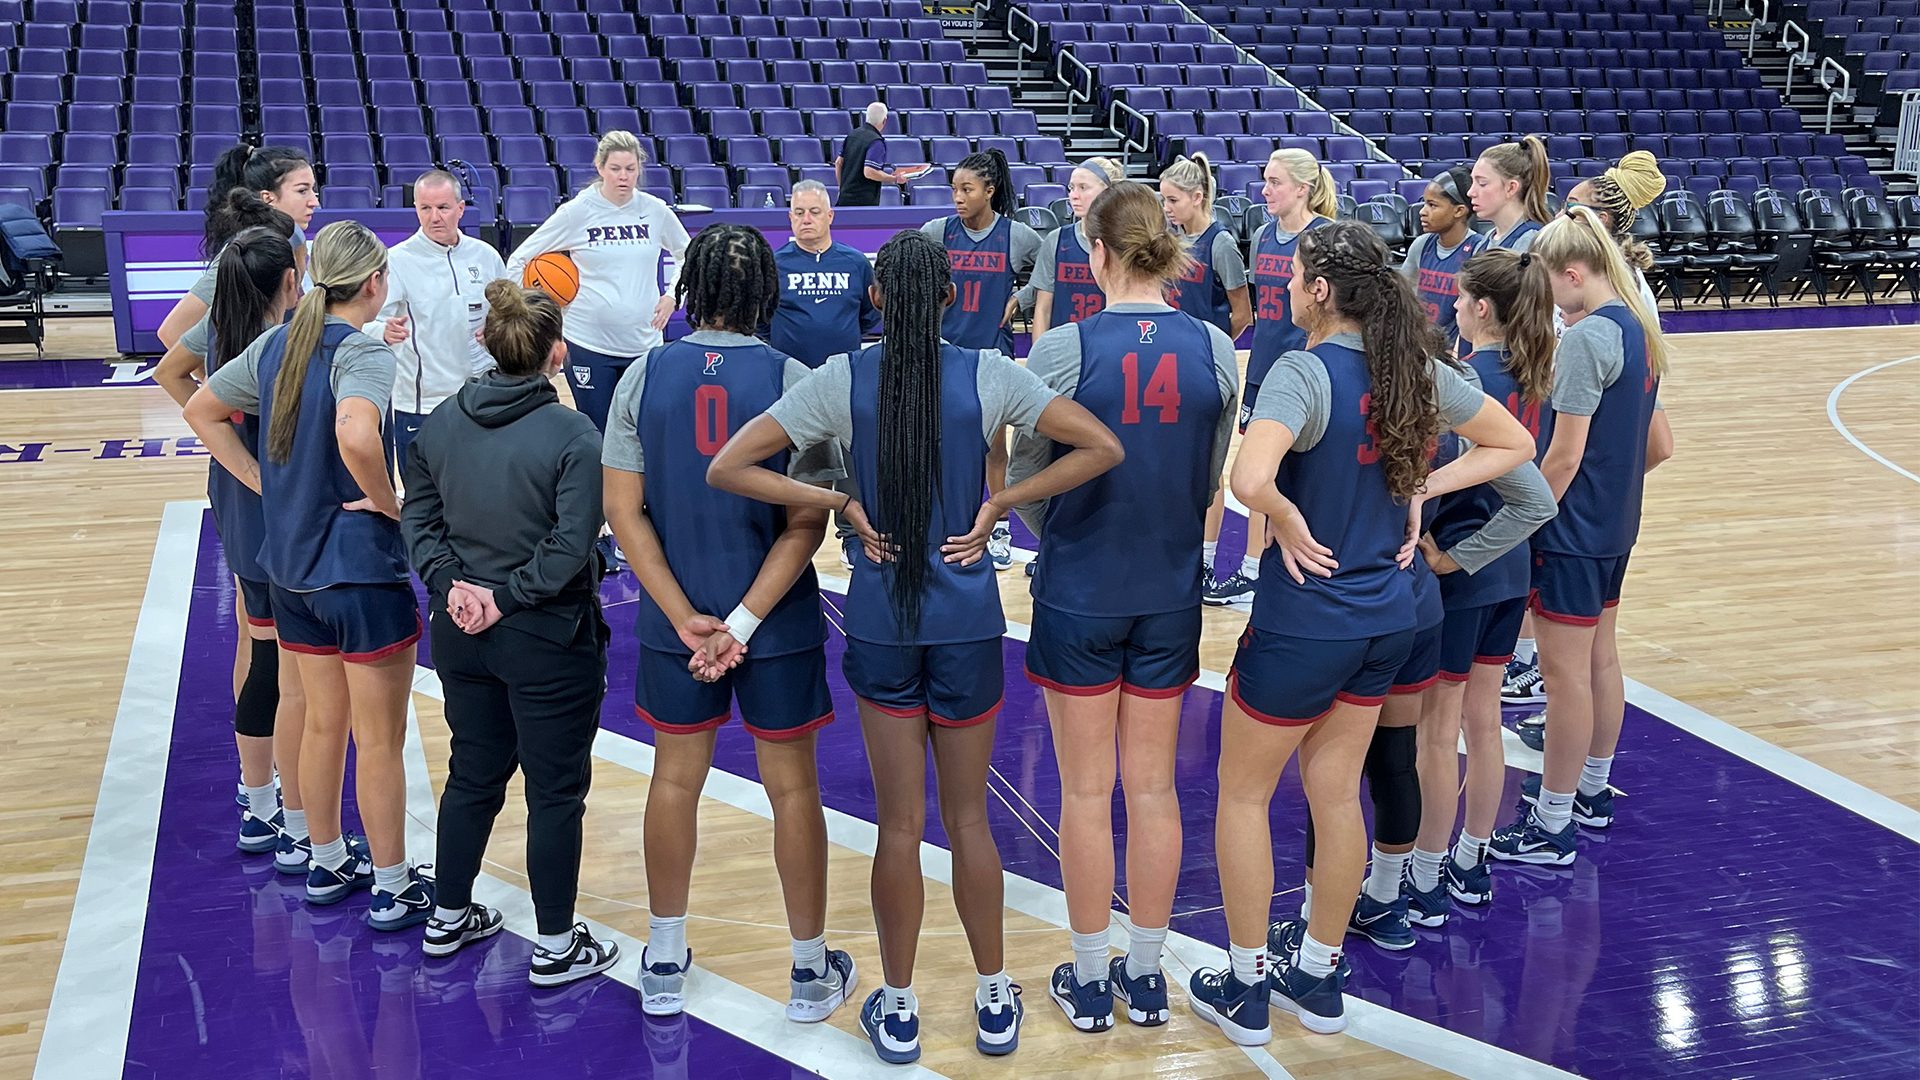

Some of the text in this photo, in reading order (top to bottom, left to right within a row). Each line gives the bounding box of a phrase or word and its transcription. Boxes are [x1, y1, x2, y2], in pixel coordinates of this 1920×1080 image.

[968, 20, 984, 28] SEP
[1028, 209, 1041, 226] N
[587, 223, 650, 242] PENN
[951, 253, 1001, 269] PENN
[787, 272, 851, 290] PENN
[1064, 265, 1094, 280] PE
[1418, 271, 1455, 291] PENN
[962, 280, 981, 312] 11
[1258, 285, 1284, 321] 25
[1070, 292, 1102, 323] 32
[1137, 321, 1158, 344] P
[703, 352, 724, 375] P
[1121, 352, 1181, 424] 14
[695, 384, 728, 456] 0
